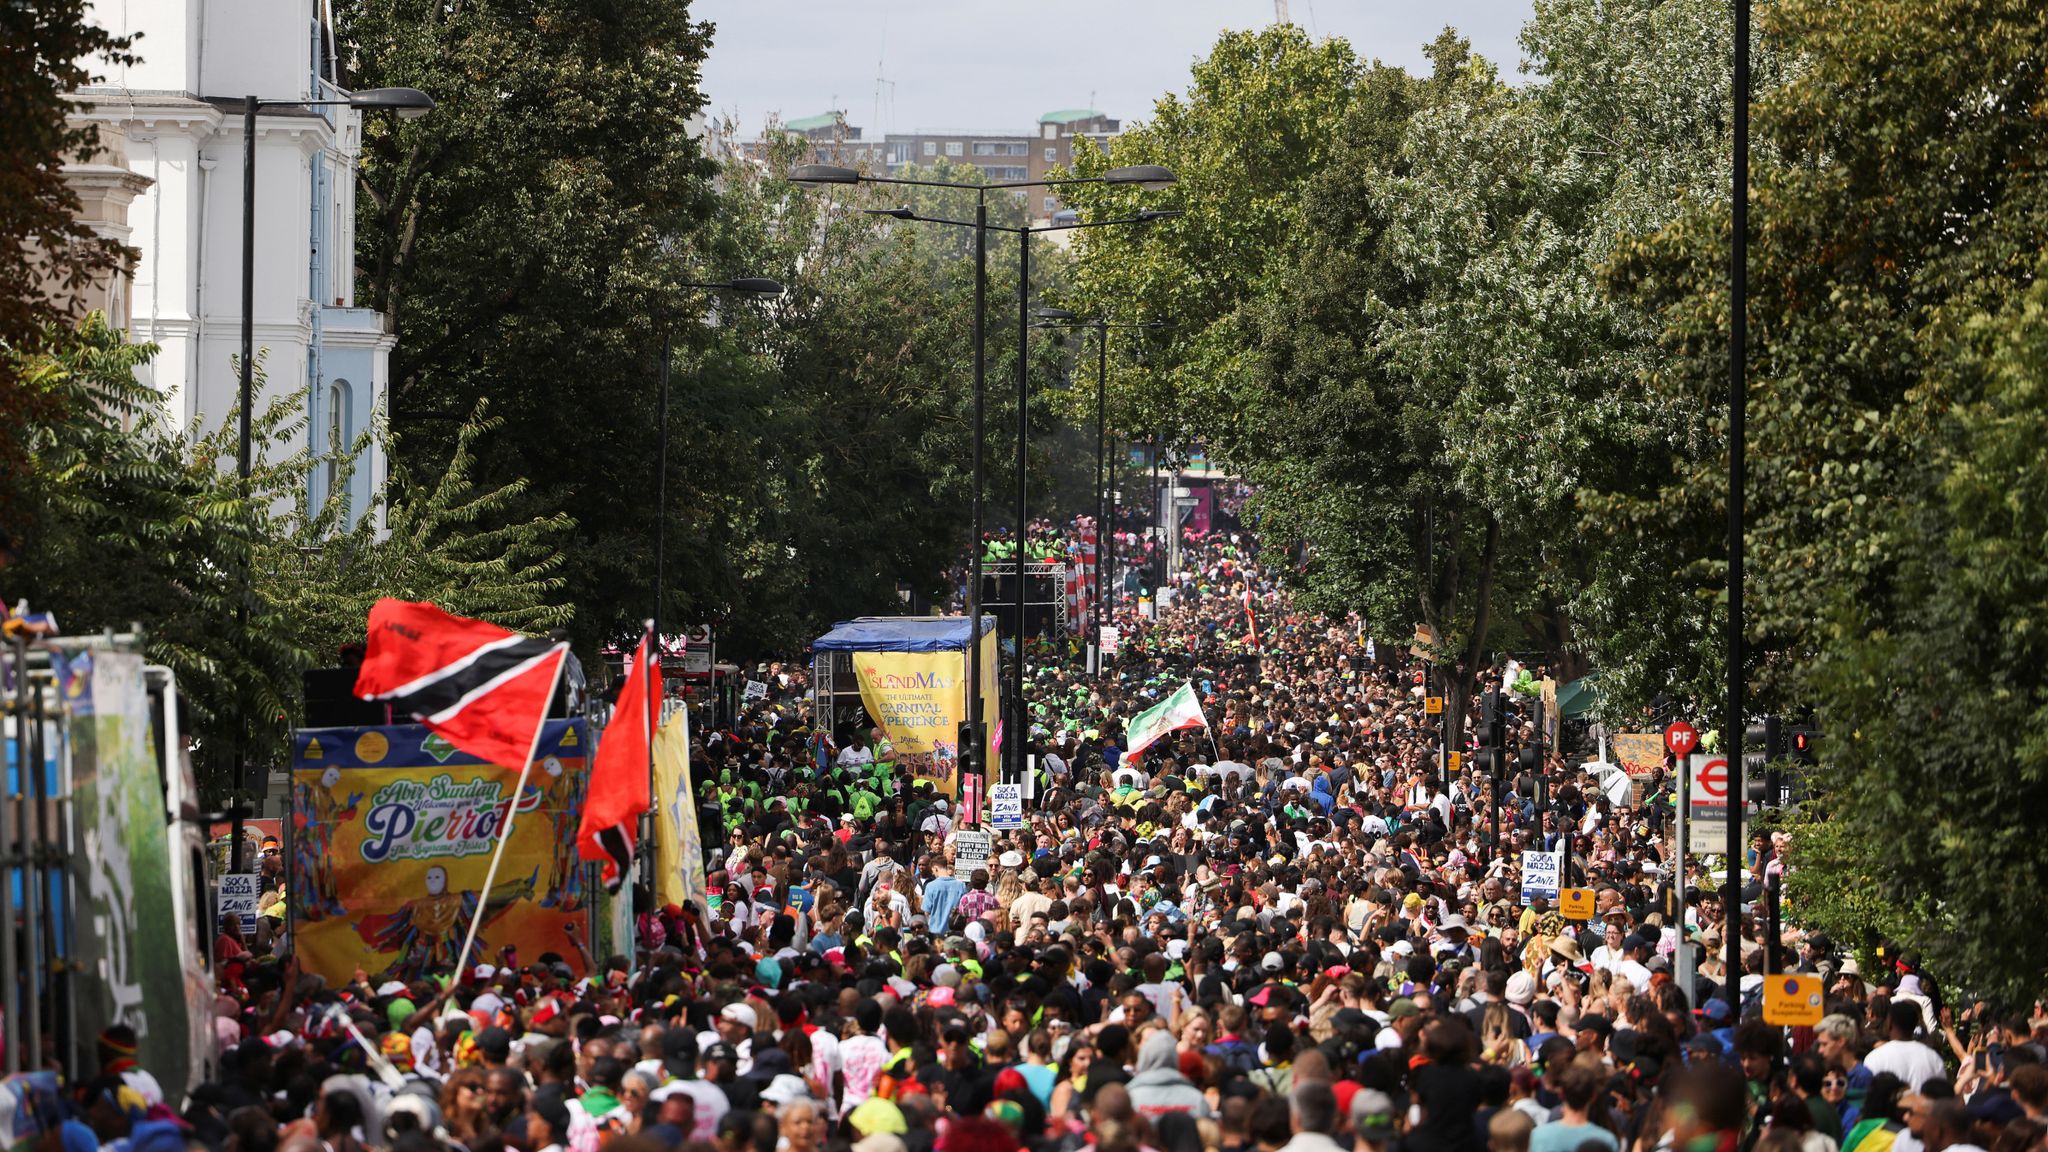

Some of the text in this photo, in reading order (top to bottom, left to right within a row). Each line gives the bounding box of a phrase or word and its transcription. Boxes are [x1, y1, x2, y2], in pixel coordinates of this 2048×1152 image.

[880, 703, 941, 714] CARNIVAL
[1672, 731, 1692, 746] PF
[429, 776, 500, 803] Sunday
[997, 786, 1016, 794] SOCA
[995, 803, 1018, 812] ZANTE
[1529, 854, 1553, 862] SOCA
[1527, 862, 1555, 870] MAZZA
[225, 877, 249, 886] SOCA
[1525, 874, 1555, 886] ZANTE
[222, 886, 252, 895] MAZZA
[221, 899, 253, 911] ZANTE
[1778, 1001, 1805, 1010] Parking
[1771, 1009, 1813, 1017] Suspension
